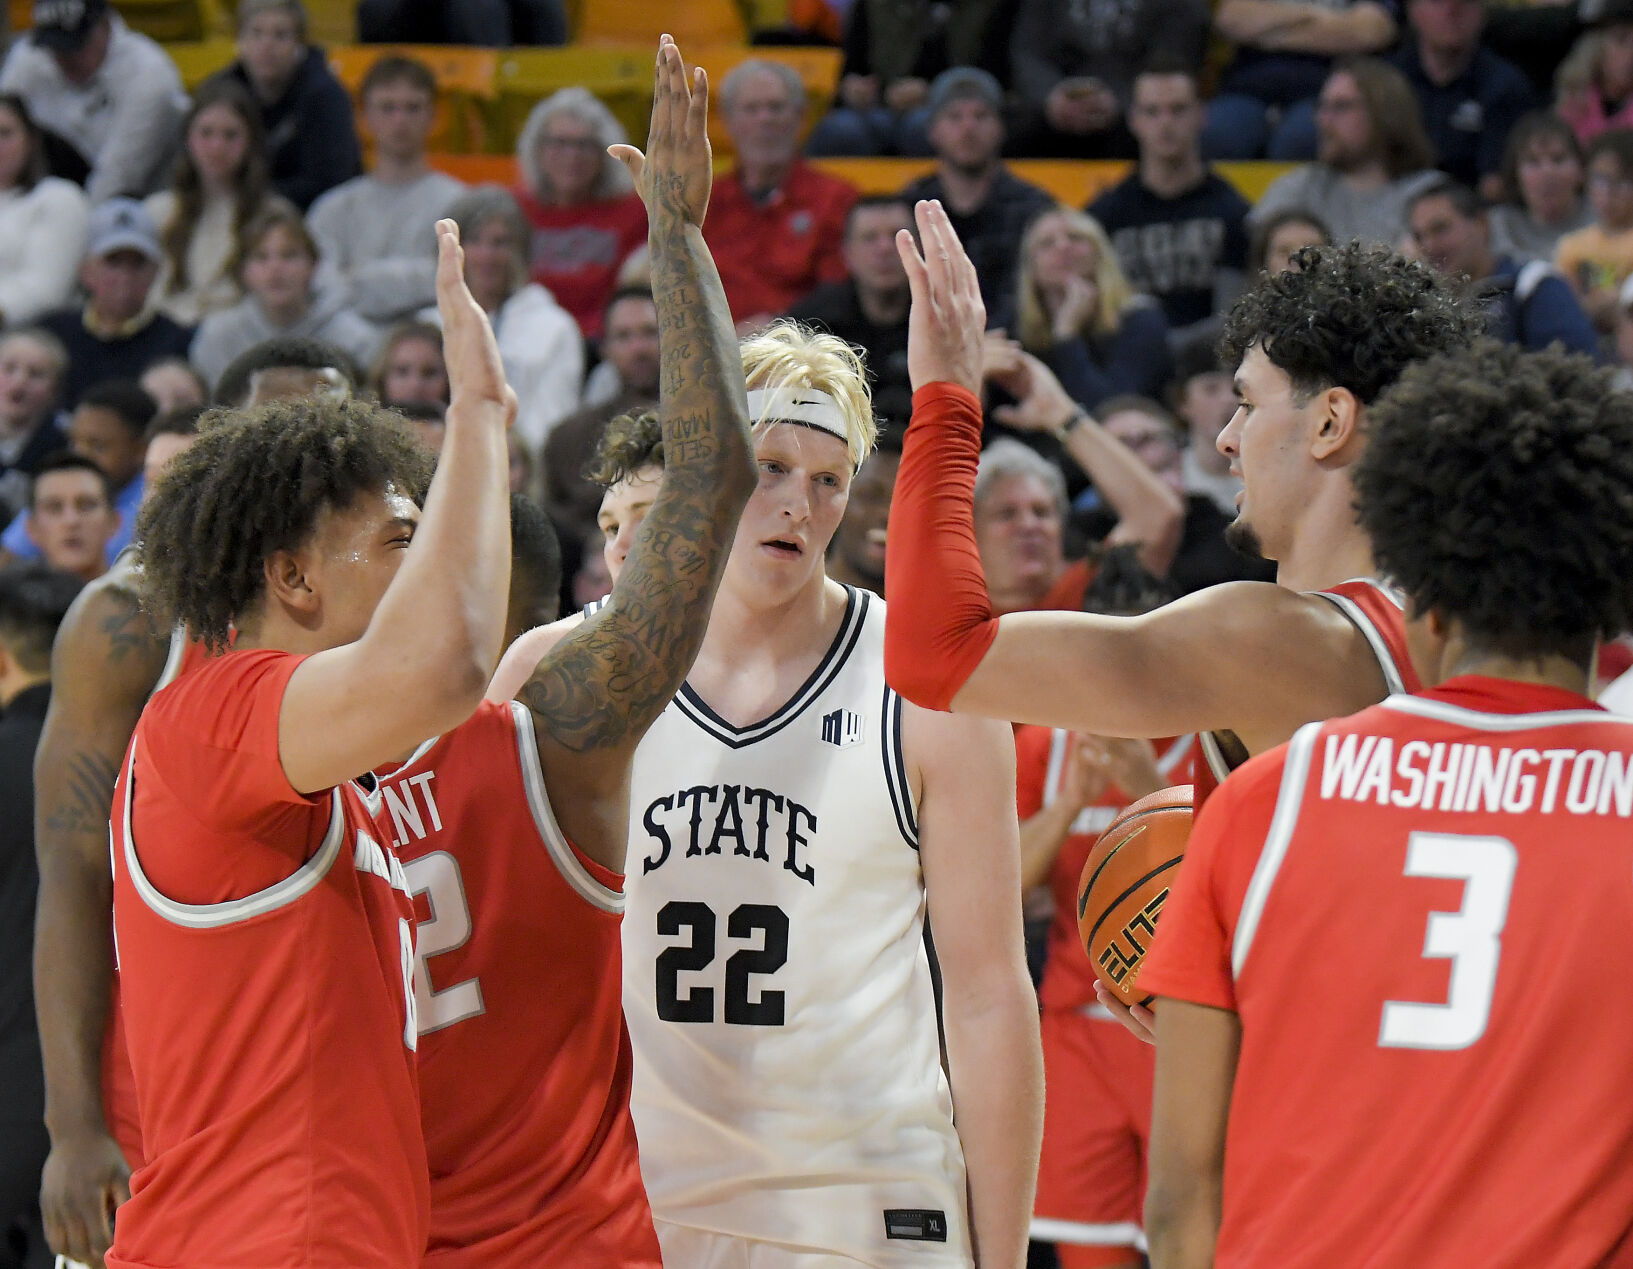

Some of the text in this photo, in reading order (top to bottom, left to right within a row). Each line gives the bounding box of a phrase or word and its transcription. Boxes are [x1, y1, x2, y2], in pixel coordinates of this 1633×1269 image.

[379, 770, 443, 848] NT
[1320, 733, 1633, 817] WASHINGTON
[643, 783, 818, 886] STATE
[655, 901, 790, 1026] 22
[1377, 830, 1519, 1050] 3
[929, 1219, 941, 1232] XL
